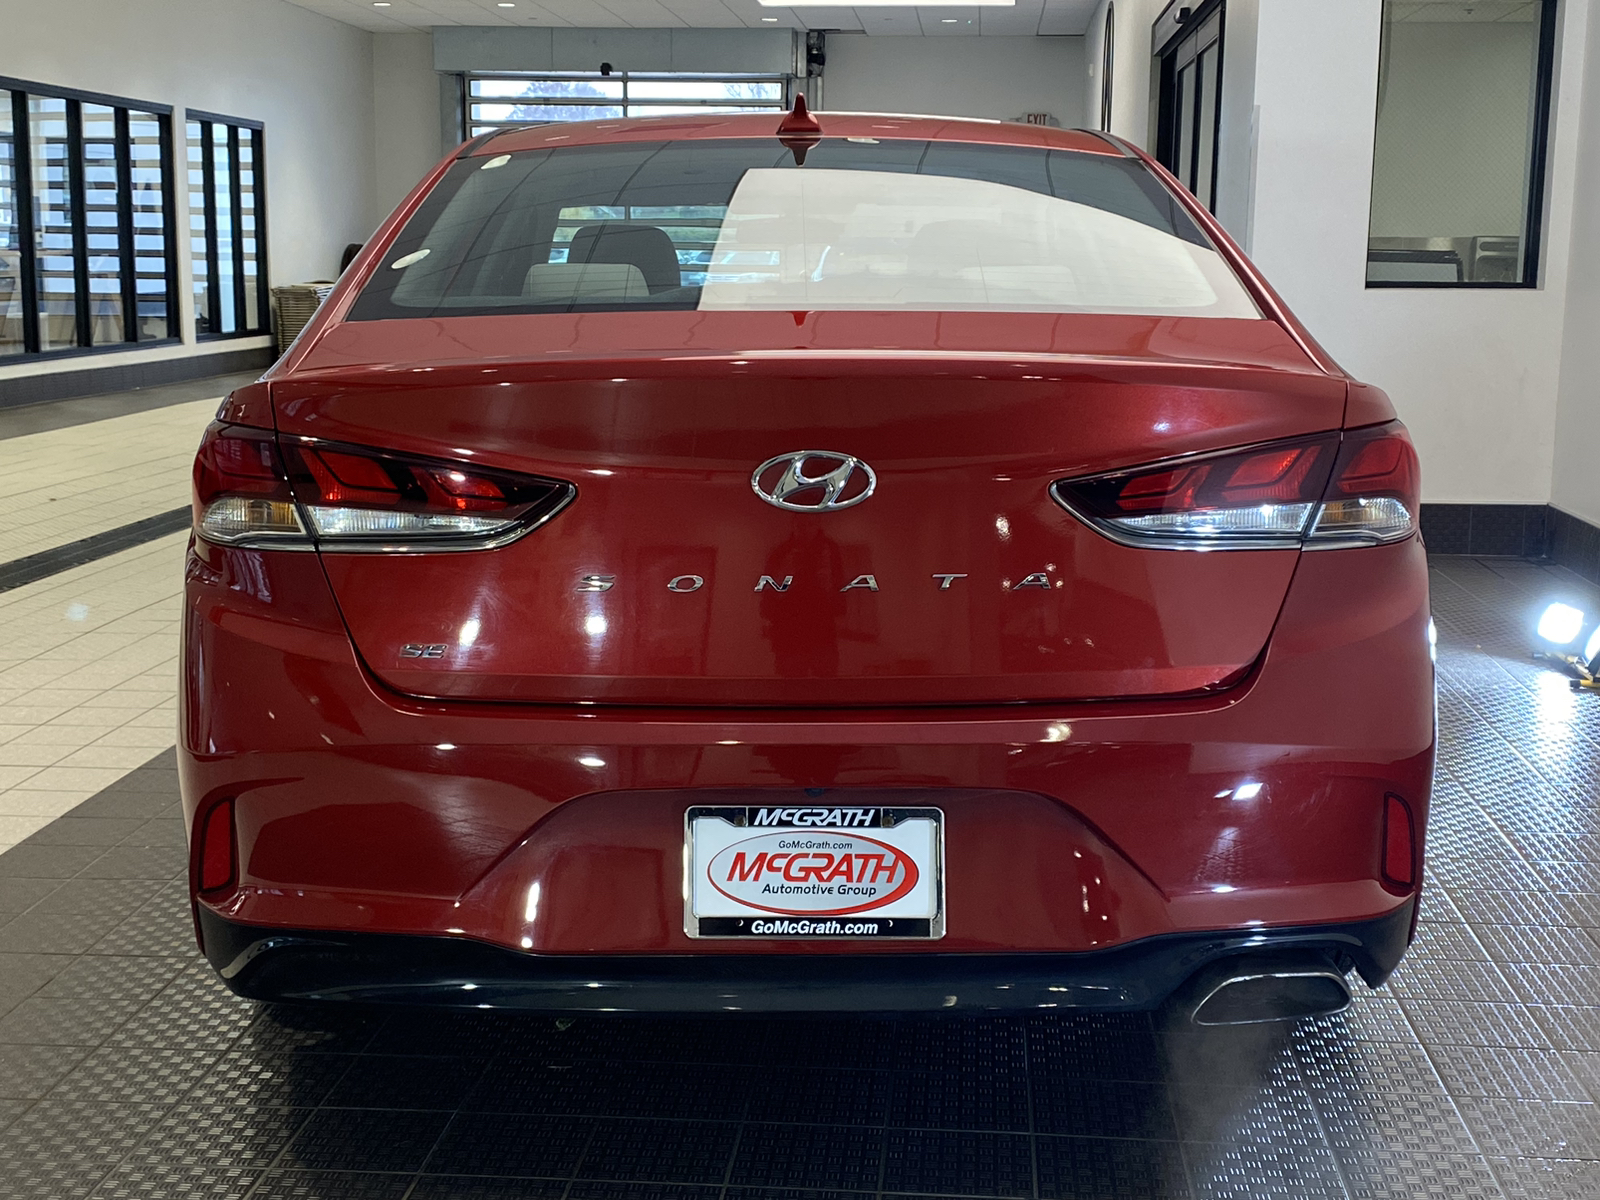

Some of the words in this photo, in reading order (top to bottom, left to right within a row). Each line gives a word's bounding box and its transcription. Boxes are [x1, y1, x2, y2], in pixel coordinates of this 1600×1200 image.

[1027, 113, 1047, 125] EXIT
[576, 572, 1052, 593] SONATA
[400, 644, 447, 658] SE
[778, 840, 853, 850] GoMcGrath.com
[761, 884, 834, 895] Automotive
[837, 884, 877, 898] Group
[751, 920, 879, 935] GoMcGrath.com
